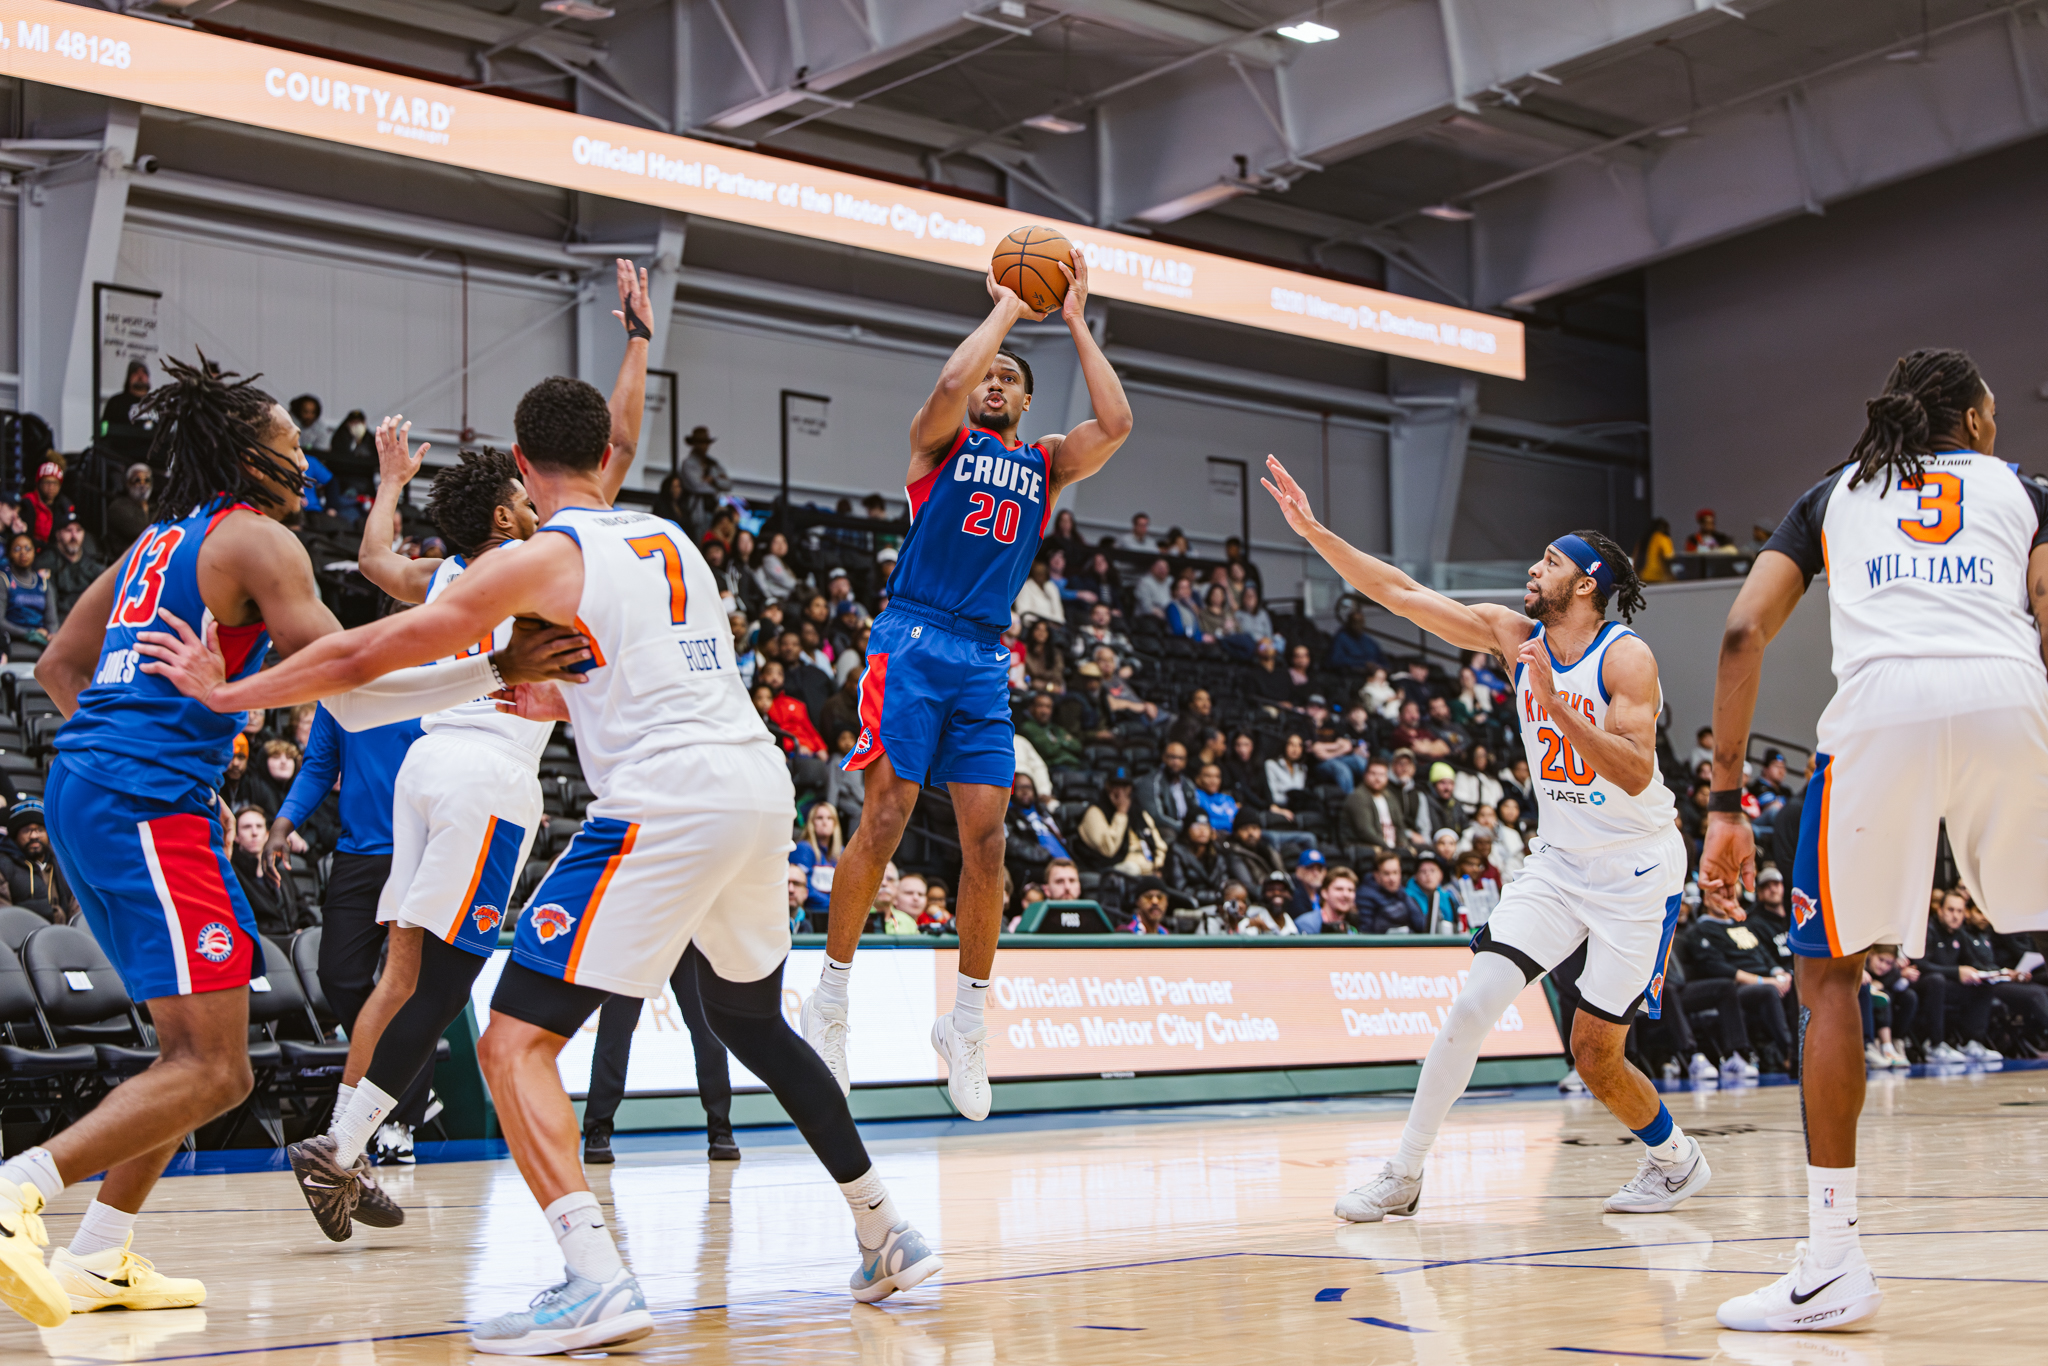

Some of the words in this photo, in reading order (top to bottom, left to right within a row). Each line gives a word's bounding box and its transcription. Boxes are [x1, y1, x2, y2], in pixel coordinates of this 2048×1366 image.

[18, 20, 49, 53] MI
[55, 29, 131, 69] 48126
[265, 67, 450, 131] COURTYARD
[572, 136, 646, 175] Official
[648, 152, 702, 187] Hotel
[704, 164, 777, 202] Partner
[777, 183, 800, 207] of
[800, 186, 832, 214] the
[834, 192, 890, 226] Motor
[890, 203, 927, 239] City
[928, 212, 985, 246] Cruise
[954, 453, 1042, 504] CRUISE
[962, 491, 1021, 544] 20
[1898, 471, 1964, 545] 3
[106, 525, 186, 628] 13
[624, 532, 688, 625] 7
[1865, 553, 1993, 589] WILLIAMS
[97, 648, 140, 684] JONES
[679, 638, 722, 671] ROBY
[1537, 726, 1597, 786] 20
[994, 976, 1083, 1010] Official
[1081, 976, 1149, 1007] Hotel
[1148, 976, 1233, 1006] Partner
[1329, 971, 1382, 1000] 5200
[1379, 971, 1457, 1004] Mercury
[1008, 1018, 1036, 1049] of
[1037, 1018, 1081, 1048] the
[1080, 1016, 1154, 1047] Motor
[1156, 1012, 1204, 1050] City
[1205, 1011, 1280, 1045] Cruise
